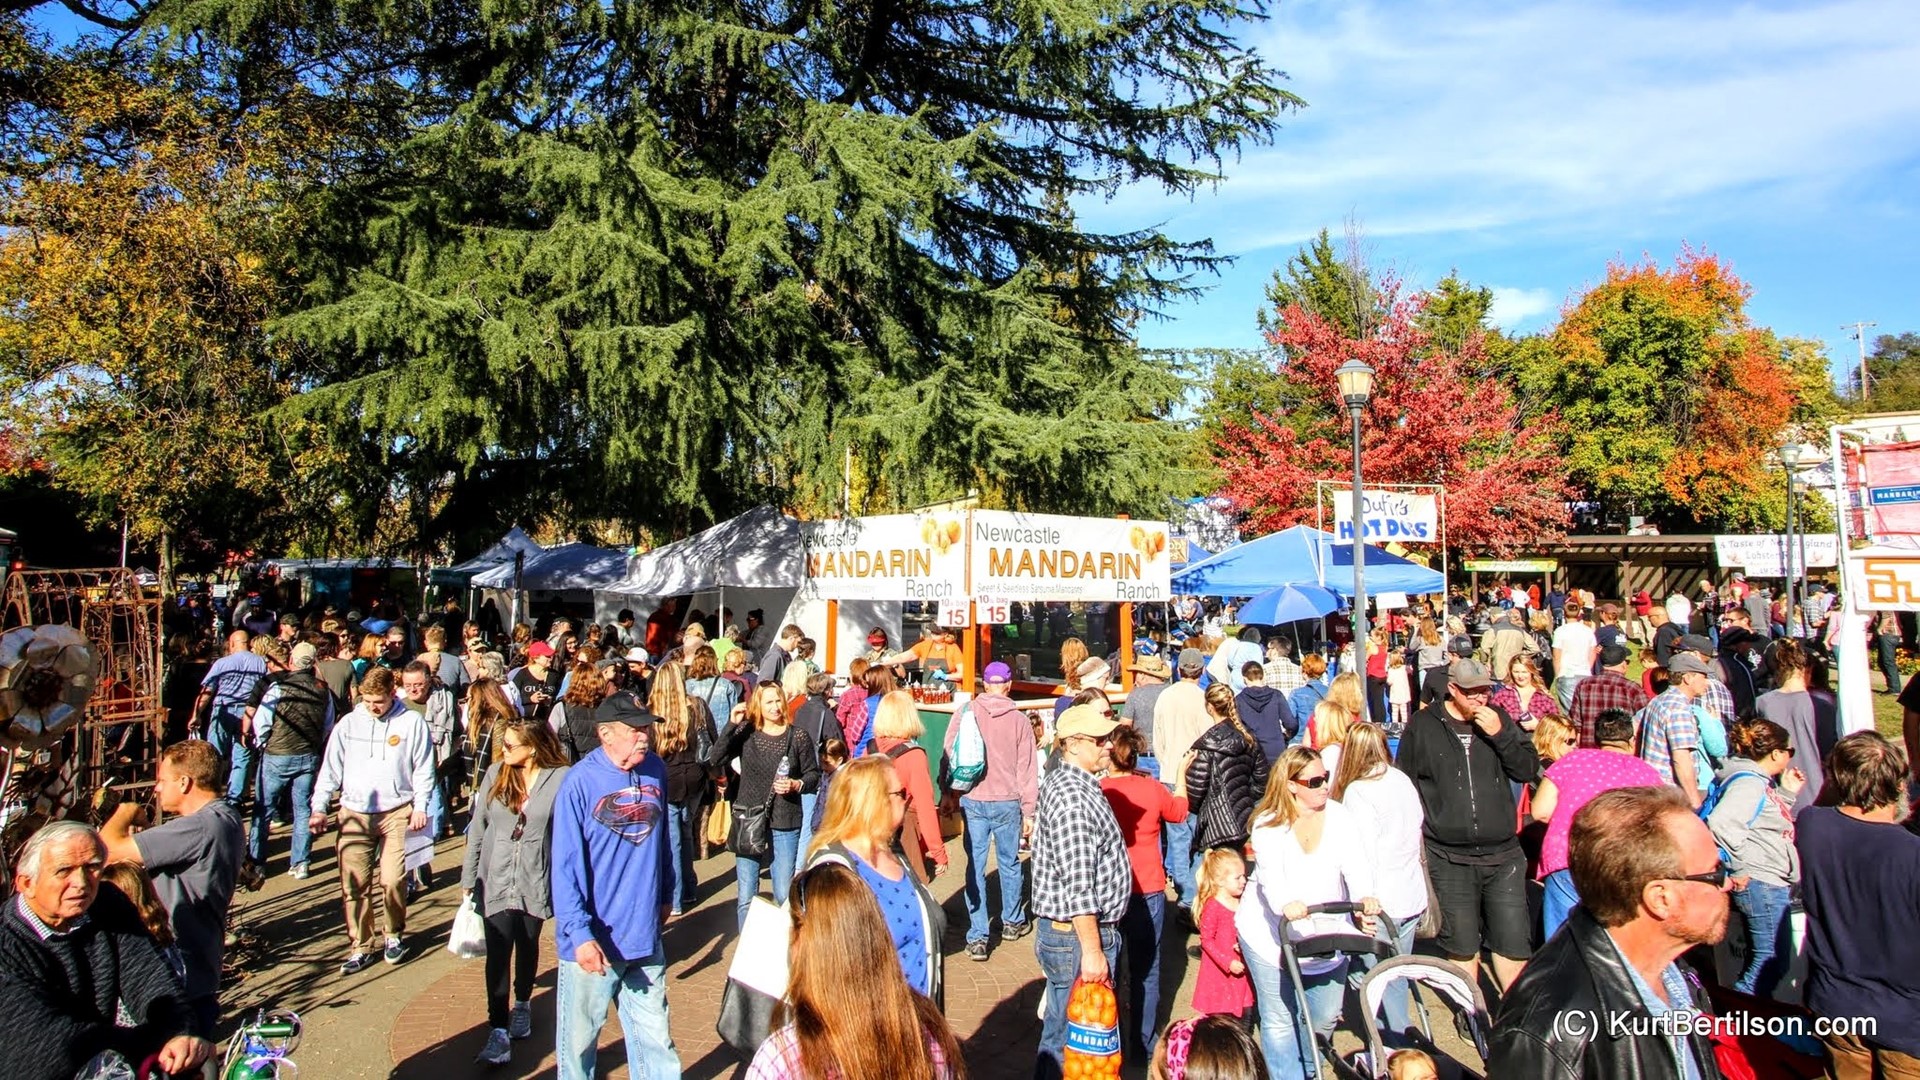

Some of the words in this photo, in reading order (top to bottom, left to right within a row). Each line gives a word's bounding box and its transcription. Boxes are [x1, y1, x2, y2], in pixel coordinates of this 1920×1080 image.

[798, 531, 858, 549] Newcastle
[976, 522, 1060, 544] Newcastle
[1729, 540, 1753, 548] Taste
[1757, 539, 1765, 547] of
[1793, 539, 1832, 549] Egland
[807, 549, 931, 578] MANDARIN
[989, 547, 1140, 580] MANDARIN
[906, 579, 952, 598] Ranch
[1116, 581, 1160, 599] Ranch
[979, 595, 989, 603] 10
[996, 597, 1009, 605] bag
[947, 610, 965, 625] 15
[987, 606, 1006, 622] 15
